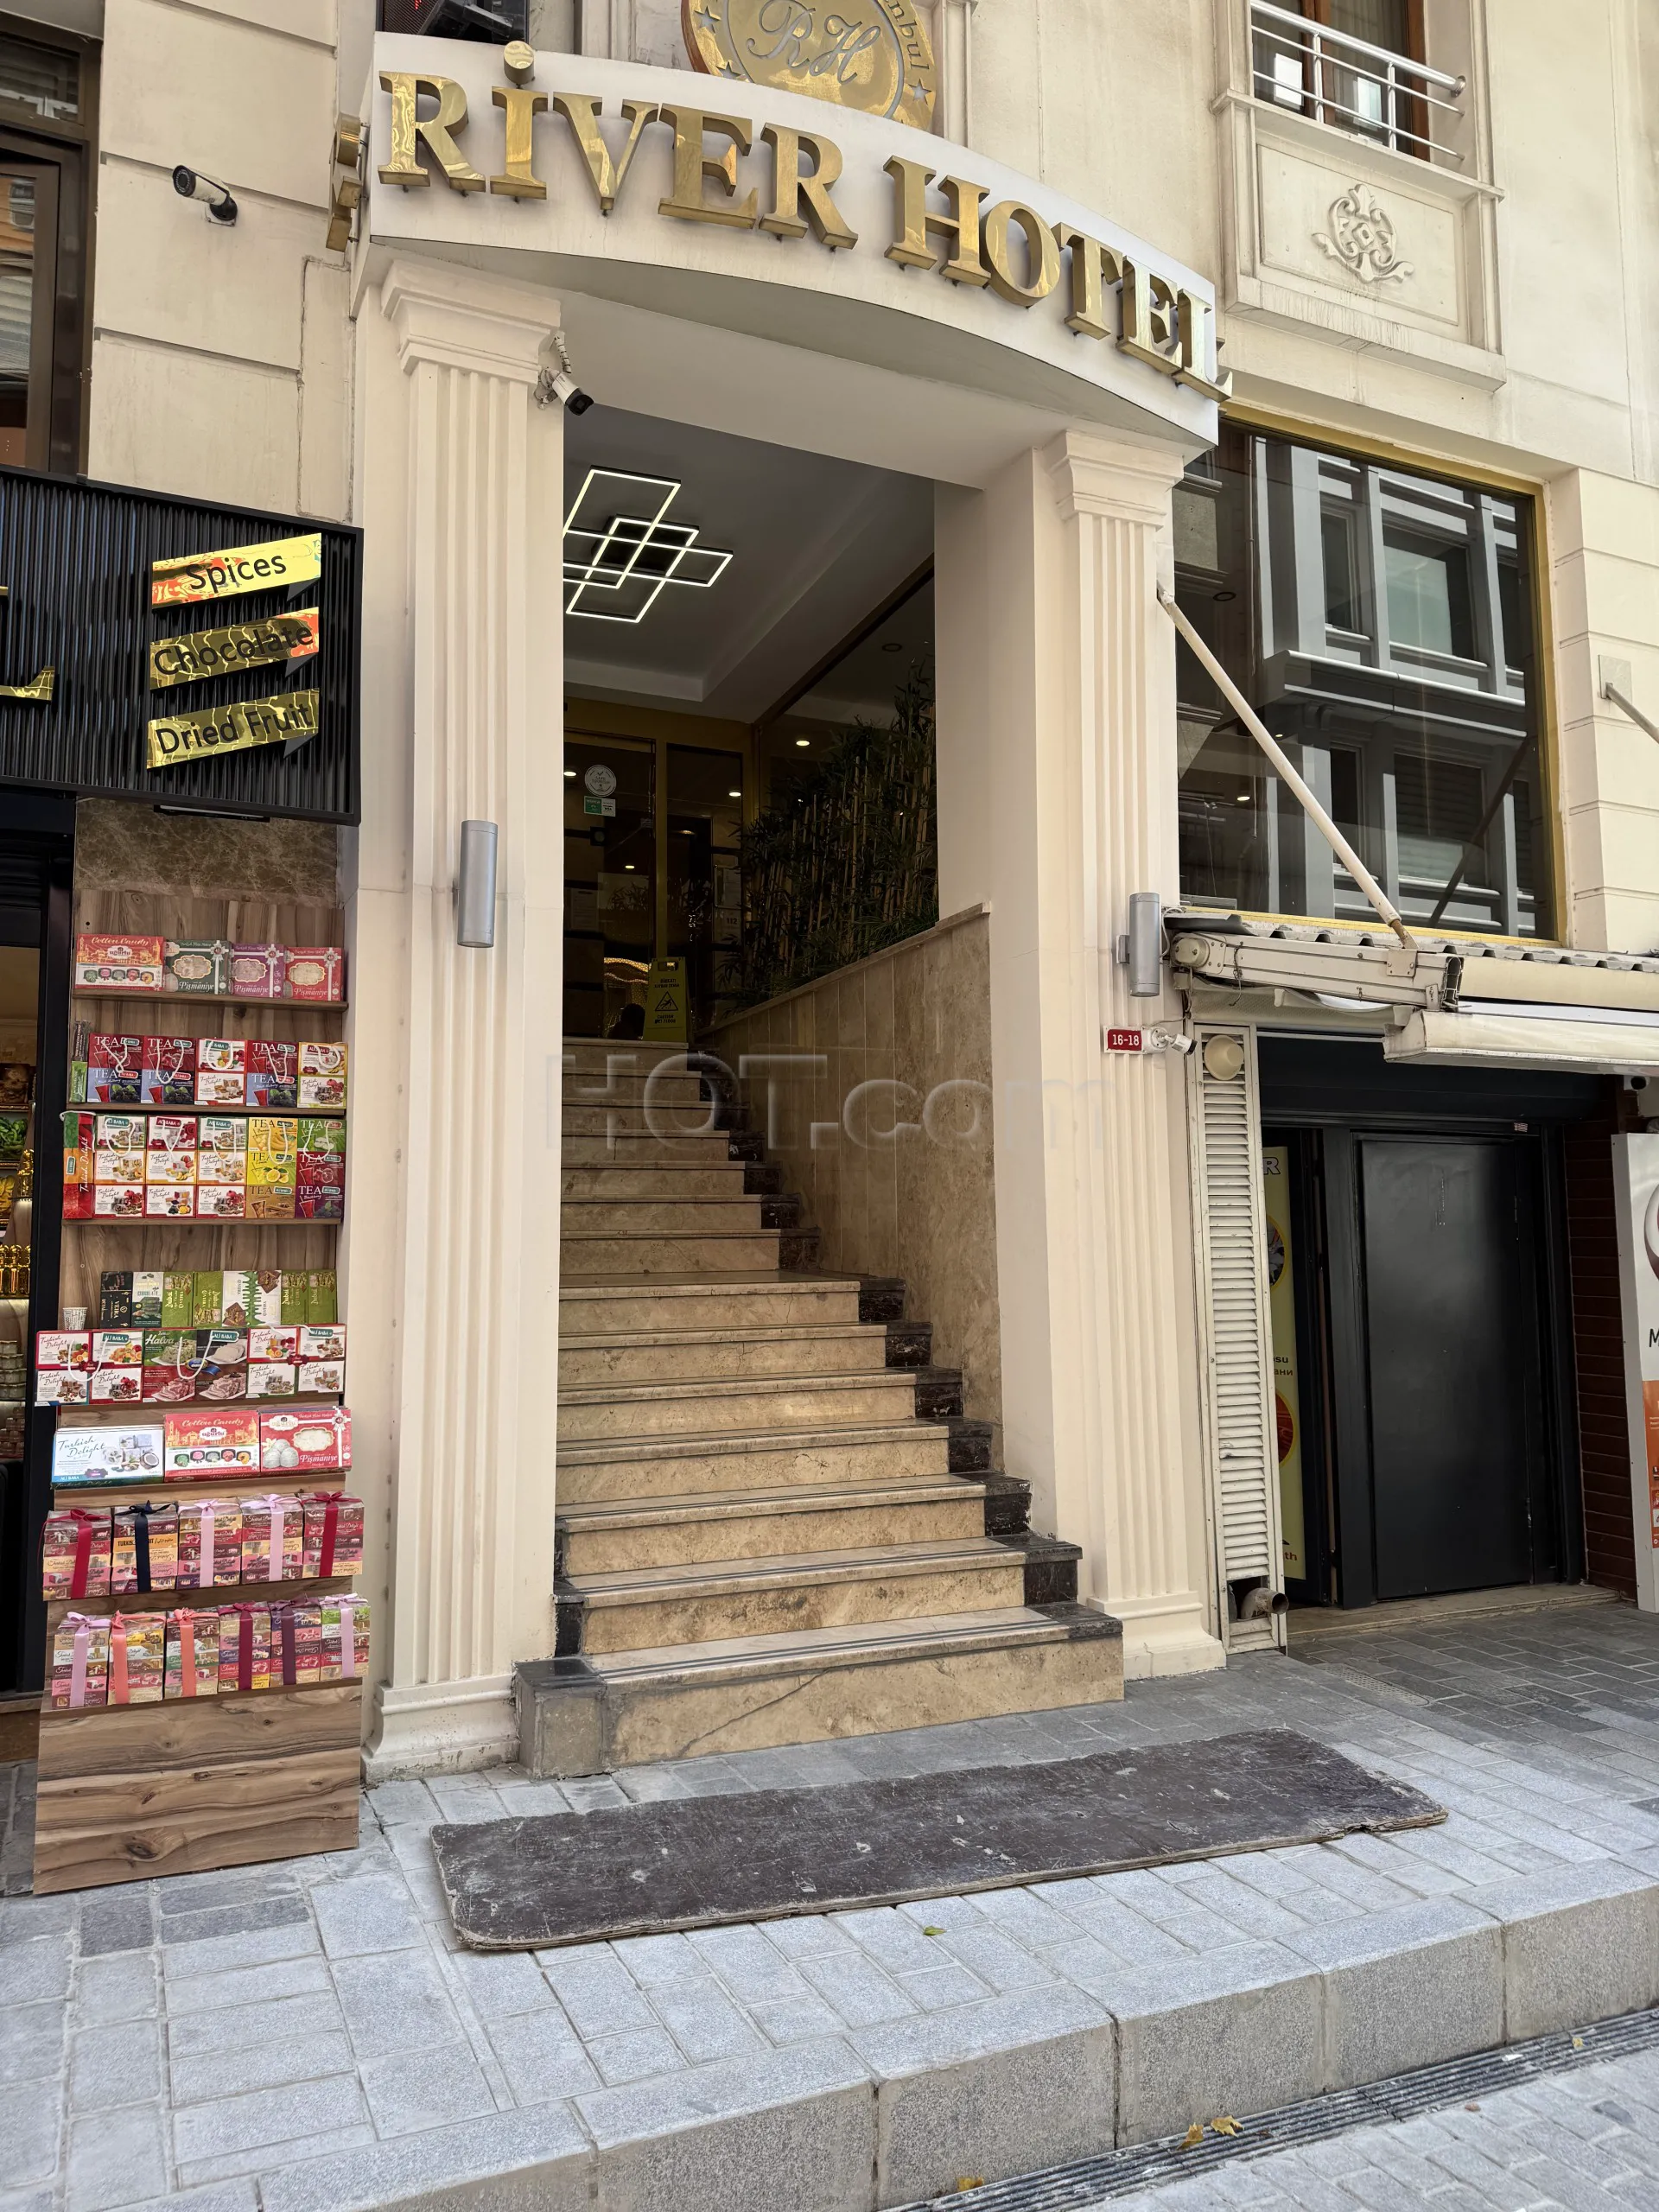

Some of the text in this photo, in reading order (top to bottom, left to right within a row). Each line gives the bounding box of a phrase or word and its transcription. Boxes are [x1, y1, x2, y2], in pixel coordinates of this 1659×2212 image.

[885, 0, 930, 69] nbul
[883, 154, 1233, 404] HOTEL
[186, 554, 287, 592] Spices
[154, 625, 314, 675] Chocolate
[156, 702, 313, 754] Dried Fruit
[95, 1037, 119, 1046] TEA
[148, 1038, 172, 1047] TEA
[1112, 1034, 1140, 1046] 16-18
[252, 1043, 276, 1052] TEA
[93, 1070, 118, 1078] TEA
[146, 1071, 171, 1080] TEA
[252, 1075, 274, 1084] TEA
[252, 1119, 275, 1128] TEA
[300, 1120, 323, 1128] TEA
[251, 1153, 270, 1161] TEA
[300, 1154, 323, 1163] TEA
[80, 1136, 91, 1192] Turkish Delight
[145, 1334, 174, 1344] Halva
[256, 1335, 276, 1344] Delight
[45, 1340, 67, 1349] Delight
[300, 1363, 320, 1372] Turkish
[304, 1368, 325, 1376] Delight
[39, 1372, 60, 1381] Turkish
[255, 1370, 275, 1378] Delight
[44, 1376, 66, 1385] Delight
[99, 1375, 120, 1383] Delight
[58, 1435, 96, 1451] Turkish
[67, 1443, 105, 1459] Delight
